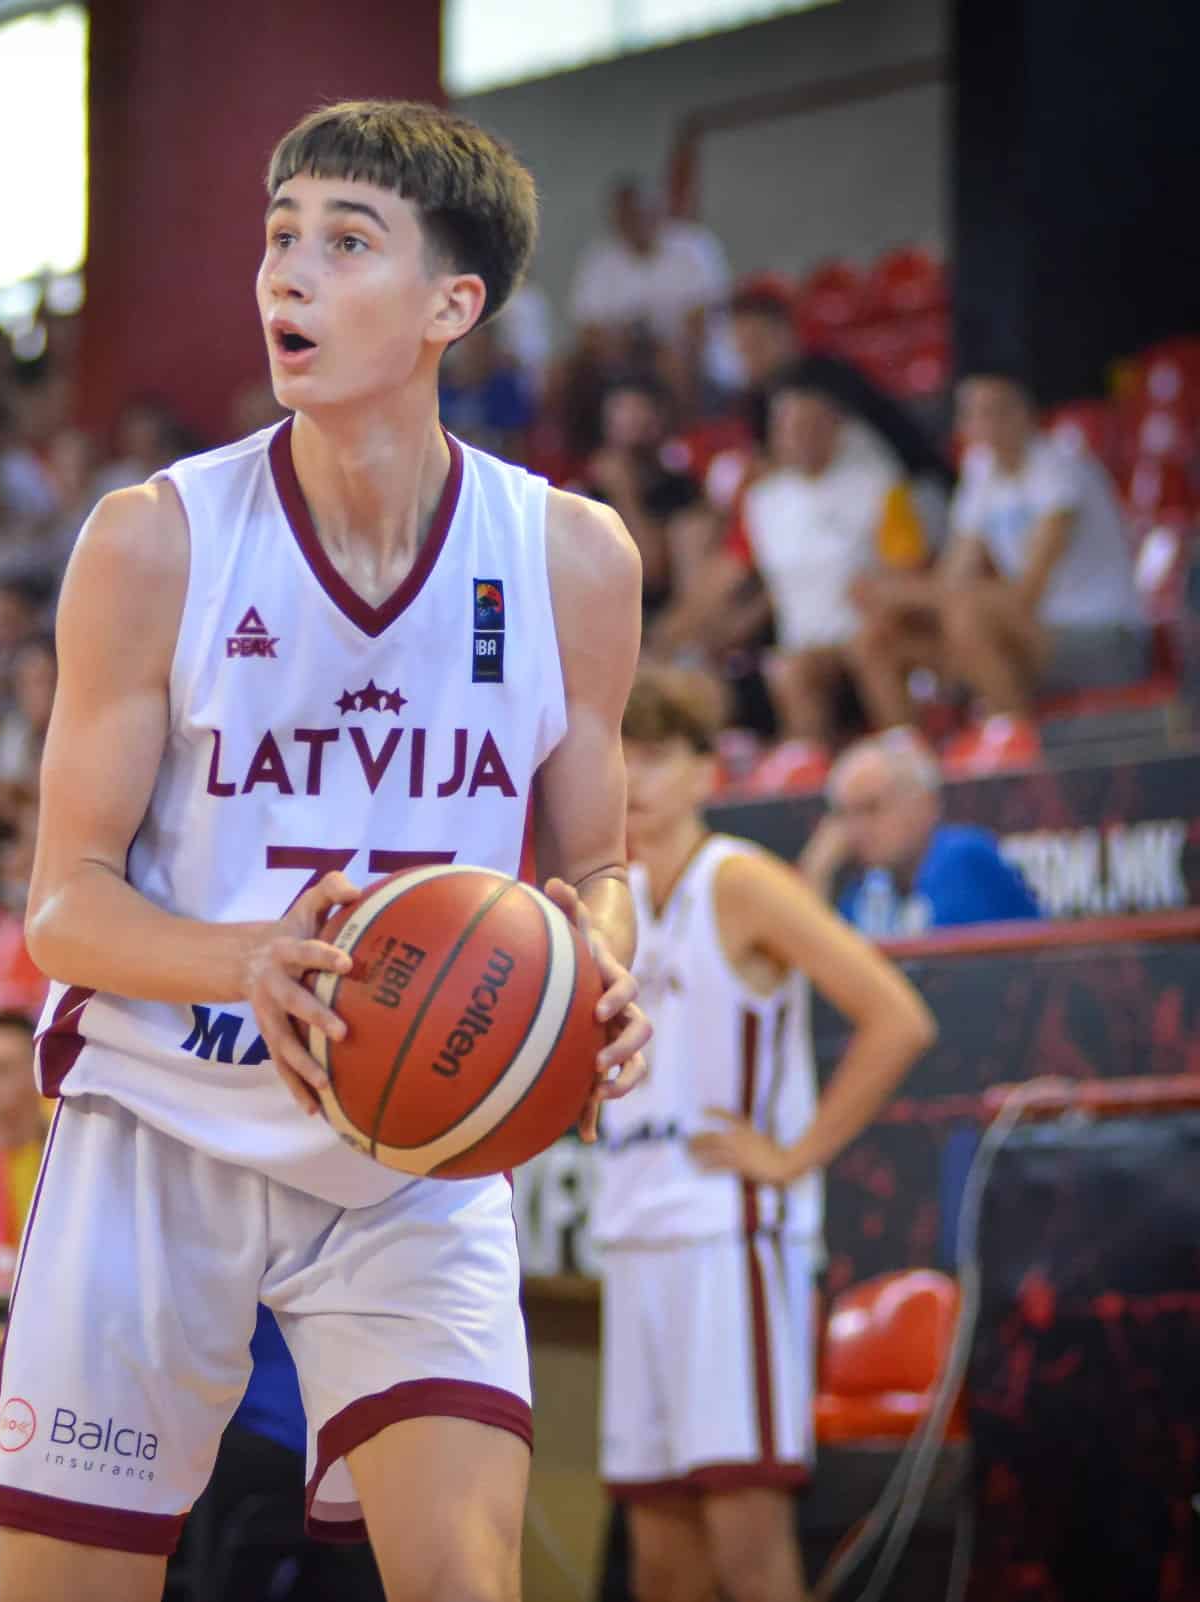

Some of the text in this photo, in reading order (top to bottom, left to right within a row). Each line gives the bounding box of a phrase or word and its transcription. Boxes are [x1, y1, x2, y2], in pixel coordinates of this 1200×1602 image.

[226, 637, 280, 658] PEAK
[206, 727, 518, 798] LATVIJA
[371, 942, 427, 1008] FIBA
[430, 947, 515, 1078] molten
[51, 1408, 159, 1460] Balcia
[45, 1453, 156, 1481] insurance
